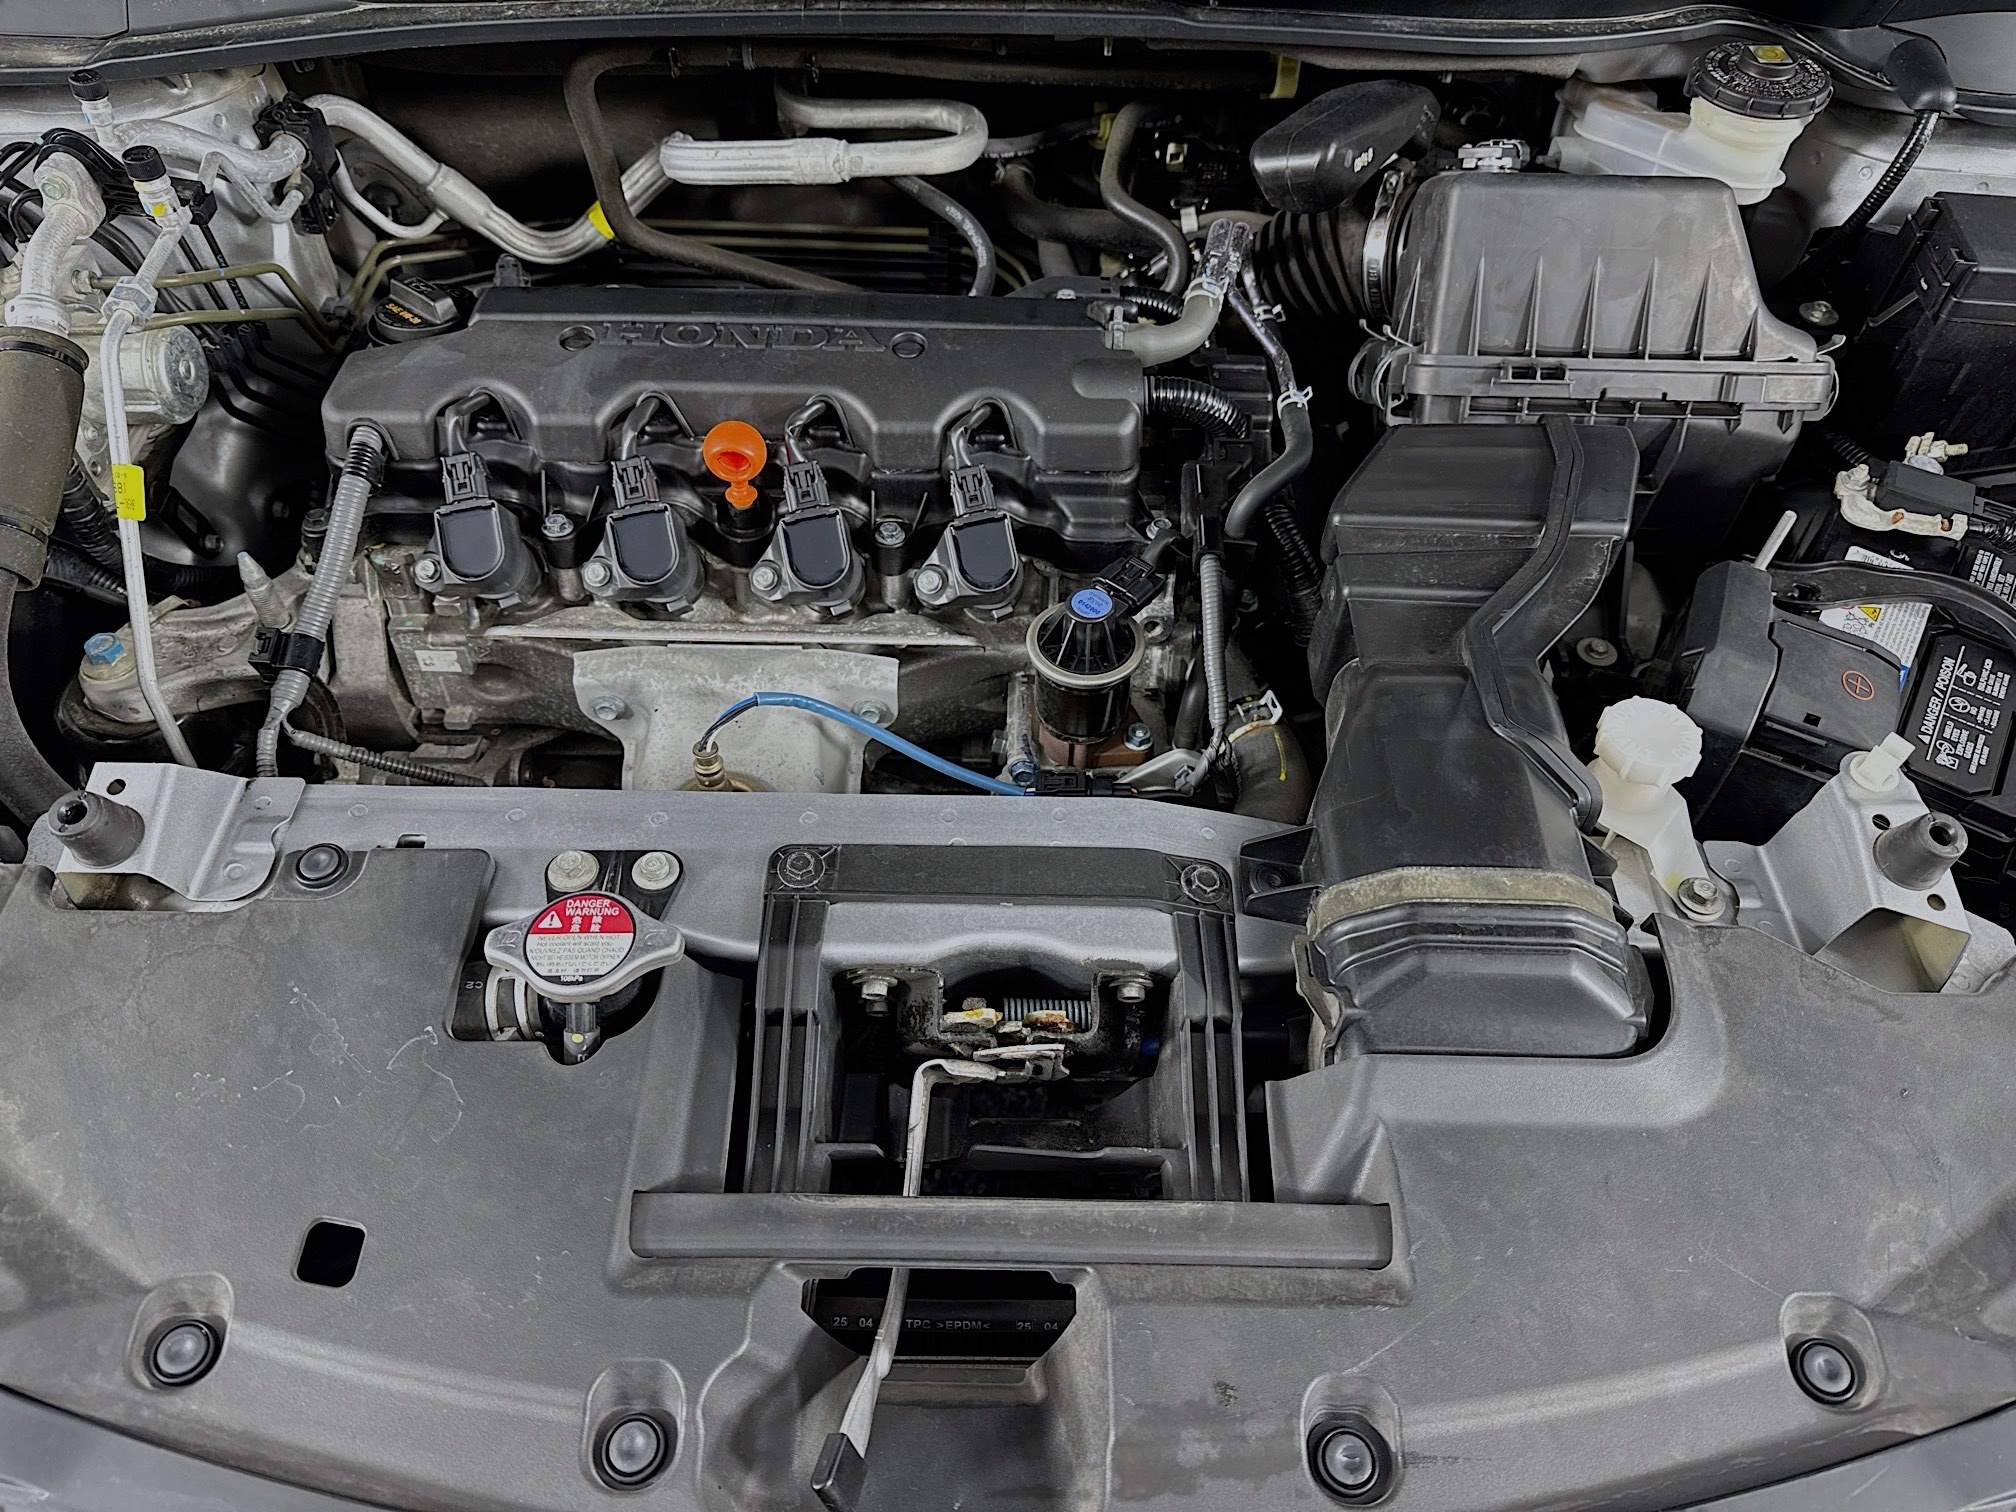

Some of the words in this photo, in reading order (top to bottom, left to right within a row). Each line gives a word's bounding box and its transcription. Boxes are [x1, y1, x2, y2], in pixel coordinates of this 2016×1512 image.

[600, 322, 885, 350] HONDA
[567, 899, 611, 908] DANGER
[565, 907, 620, 916] WARNUNG
[833, 1316, 848, 1328] 25
[859, 1317, 873, 1328] 04
[905, 1319, 931, 1330] TPC
[1016, 1320, 1032, 1331] 25
[1043, 1321, 1059, 1331] 04
